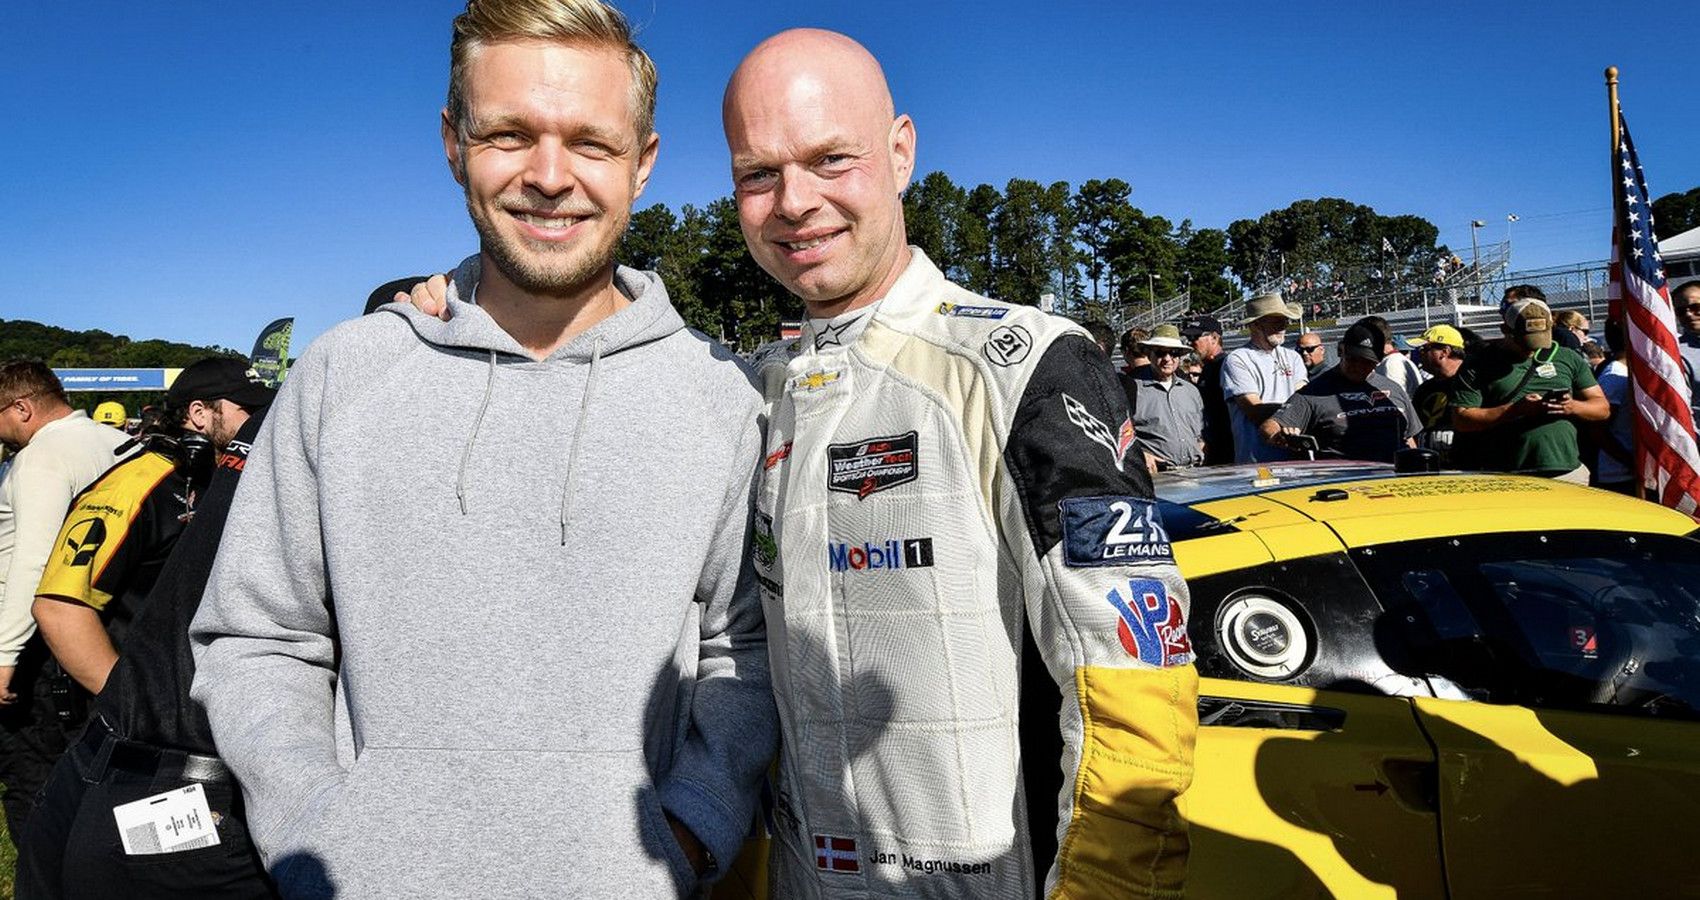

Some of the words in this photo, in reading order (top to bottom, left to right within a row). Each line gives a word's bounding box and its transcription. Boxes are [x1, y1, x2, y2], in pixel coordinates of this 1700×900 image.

[993, 334, 1022, 357] 21
[834, 451, 913, 471] WeatherTech
[829, 540, 899, 571] Mobil
[1102, 545, 1126, 558] LE
[1127, 544, 1170, 557] MANS
[1105, 577, 1170, 667] VP
[1575, 630, 1588, 646] 3
[869, 850, 897, 864] Jan
[902, 853, 991, 874] Magnussen
